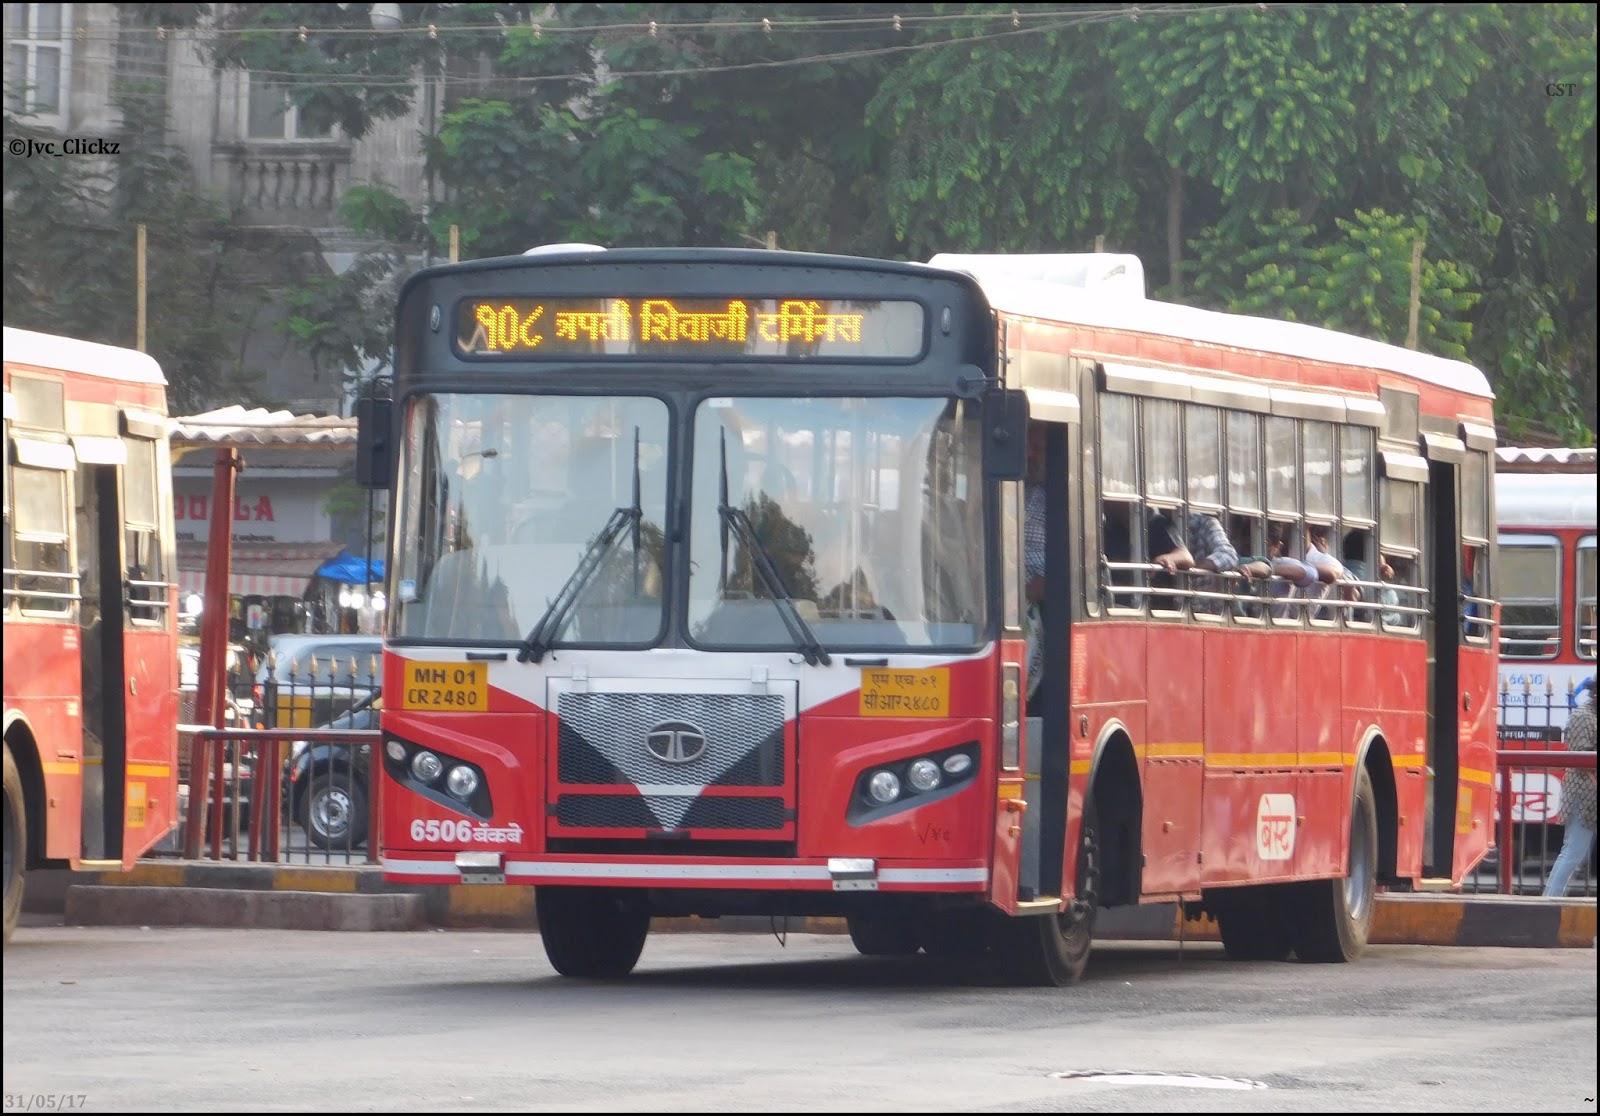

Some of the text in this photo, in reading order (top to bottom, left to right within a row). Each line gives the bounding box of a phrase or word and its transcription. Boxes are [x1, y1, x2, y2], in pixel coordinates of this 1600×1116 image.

[476, 304, 545, 350] १०८
[640, 299, 748, 342] शिवाजी
[756, 300, 864, 342] टर्मिनस
[414, 668, 477, 685] MH 01
[410, 819, 472, 843] 6506
[1260, 796, 1292, 855] बेस्ट
